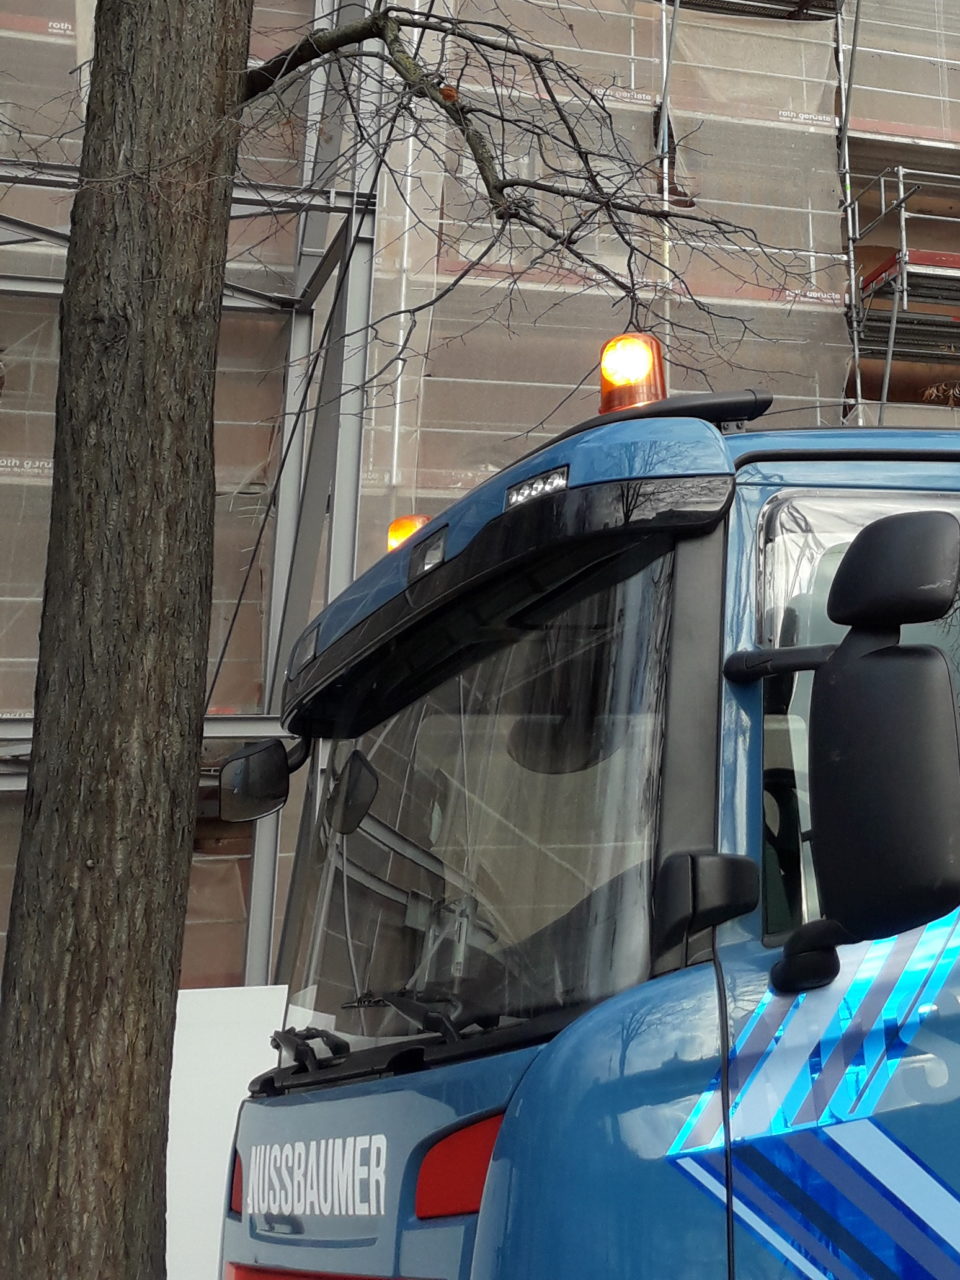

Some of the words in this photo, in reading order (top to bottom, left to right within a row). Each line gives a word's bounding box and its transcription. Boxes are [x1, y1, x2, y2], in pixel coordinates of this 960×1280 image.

[48, 22, 72, 30] roth
[799, 113, 831, 122] gerüste
[247, 1133, 387, 1217] NUSSBAUMER
